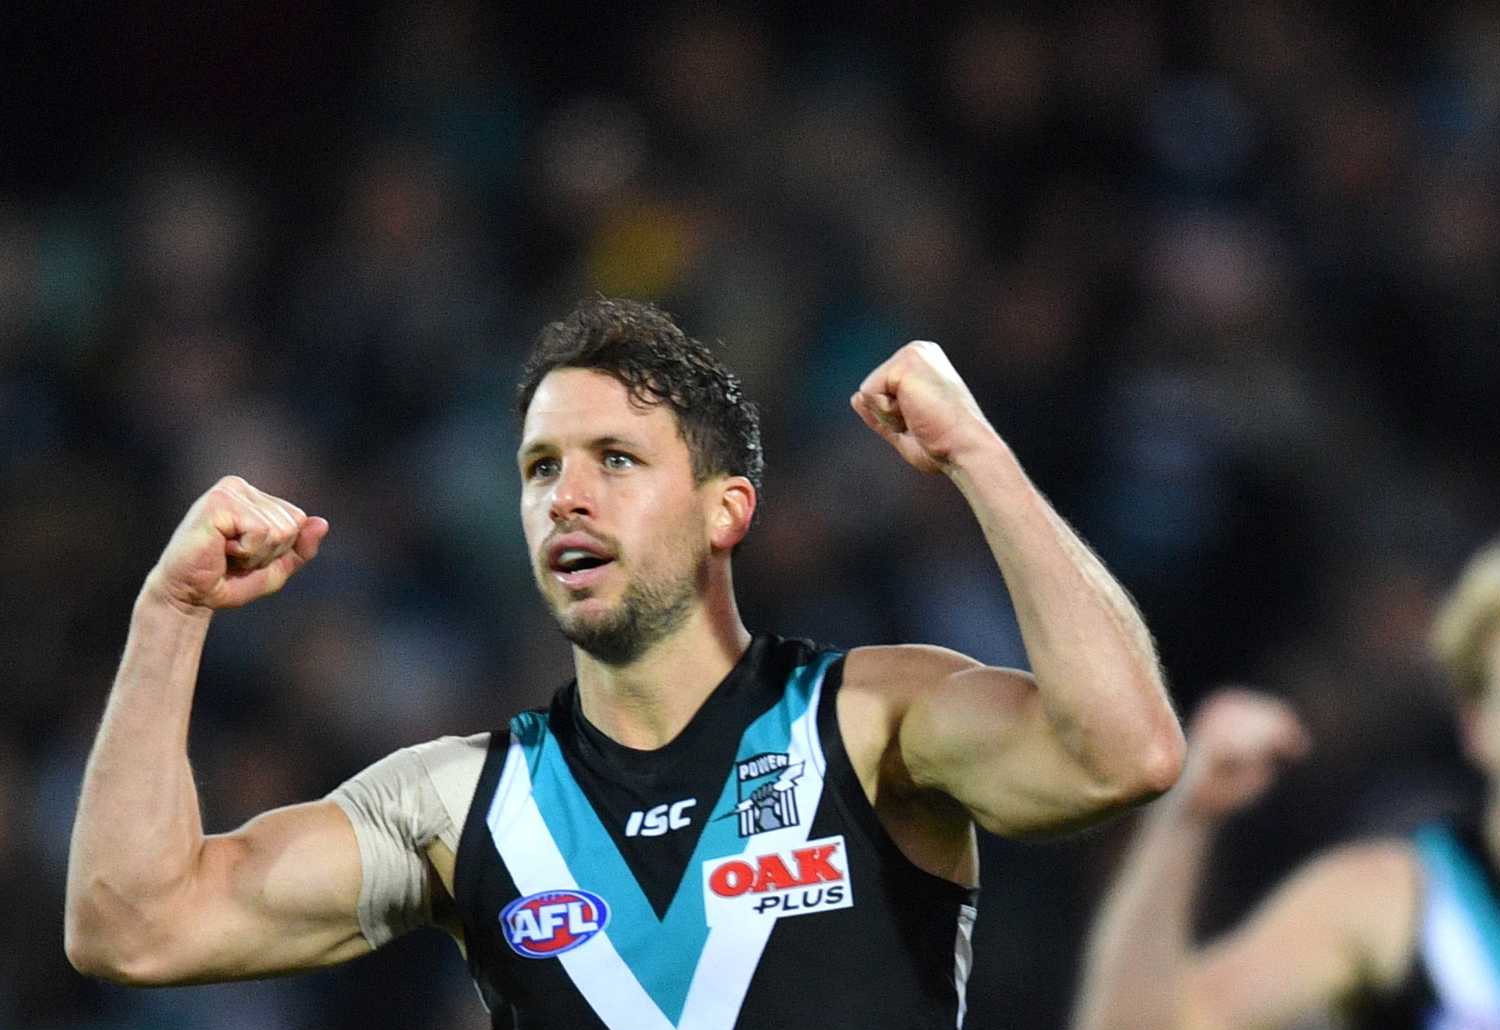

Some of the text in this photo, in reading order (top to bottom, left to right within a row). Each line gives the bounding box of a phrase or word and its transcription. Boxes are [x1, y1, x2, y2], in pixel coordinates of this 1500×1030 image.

[739, 754, 788, 780] POWER
[625, 798, 697, 837] ISC
[708, 843, 844, 898] OAK
[753, 886, 844, 914] PLUS
[512, 901, 599, 943] AFL
